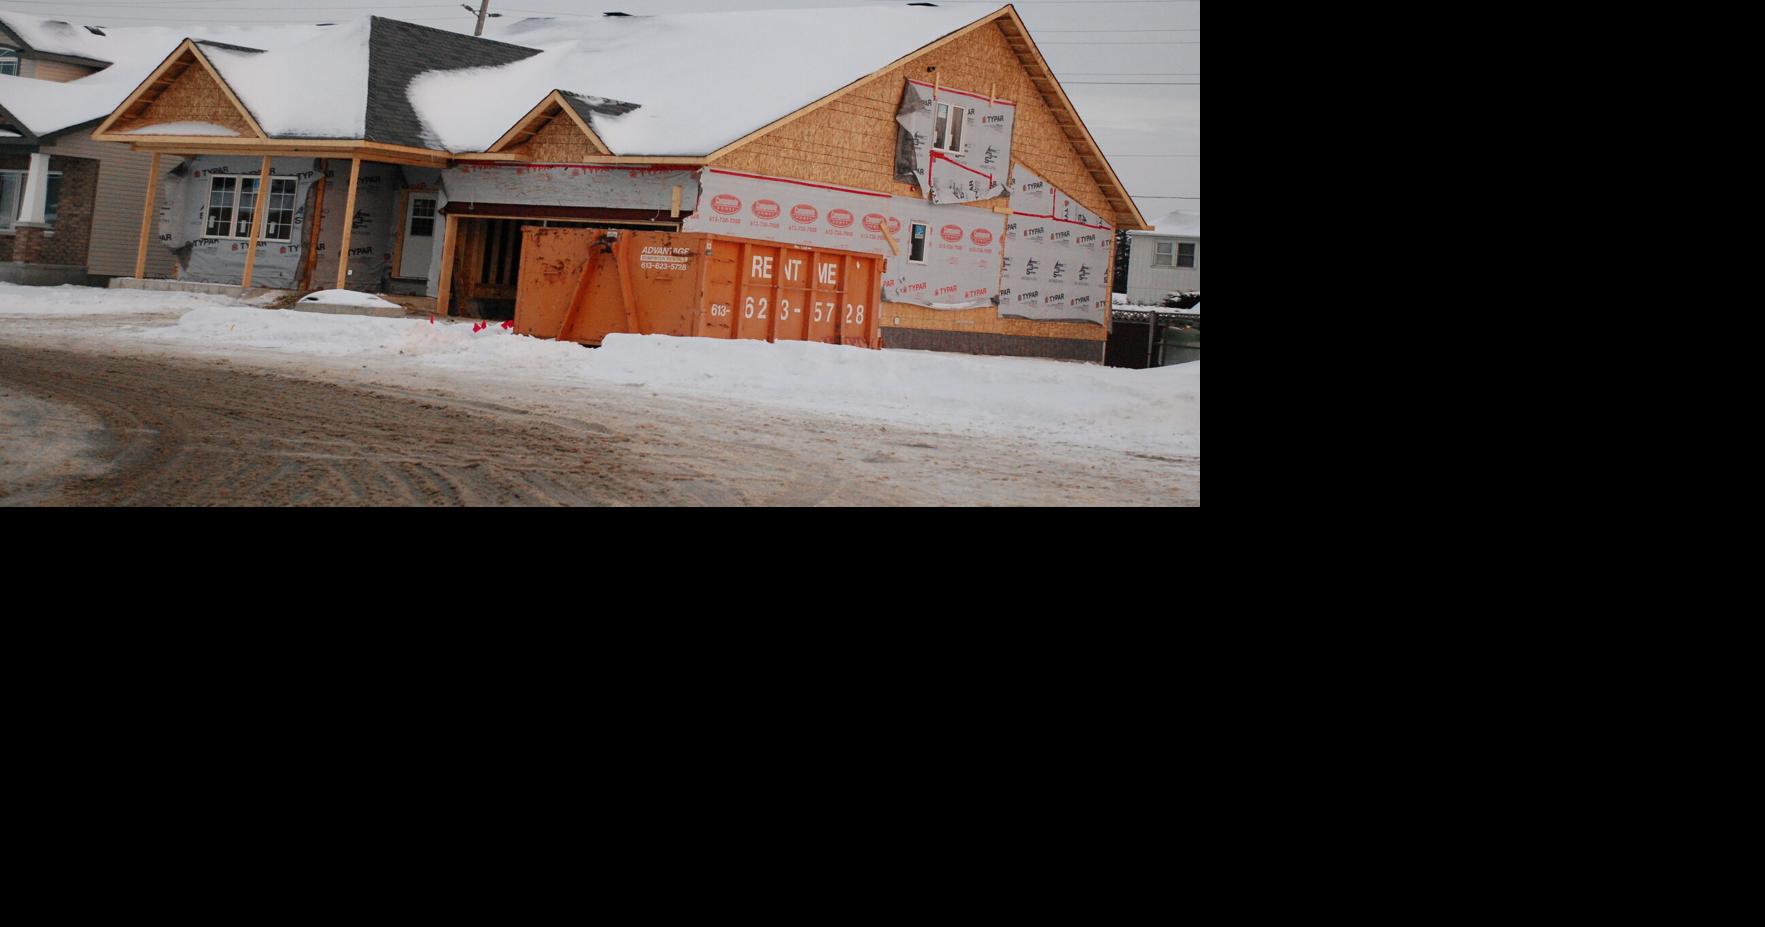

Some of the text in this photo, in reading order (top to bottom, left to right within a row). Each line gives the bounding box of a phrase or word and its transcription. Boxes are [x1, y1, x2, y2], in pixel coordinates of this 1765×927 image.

[987, 115, 1004, 123] TYPAR
[1027, 181, 1043, 190] TYPAR
[1028, 226, 1044, 235] TYPAR
[1055, 230, 1070, 239] TYPAR
[1081, 234, 1095, 243] TYPAR
[641, 262, 688, 271] 613-623-5728
[908, 282, 927, 292] TYPAR
[940, 284, 957, 295] TYPAR
[970, 287, 987, 297] TYPAR
[1022, 290, 1039, 300] TYPAR
[1049, 293, 1064, 302] TYPAR
[1075, 296, 1090, 304] TYPAR
